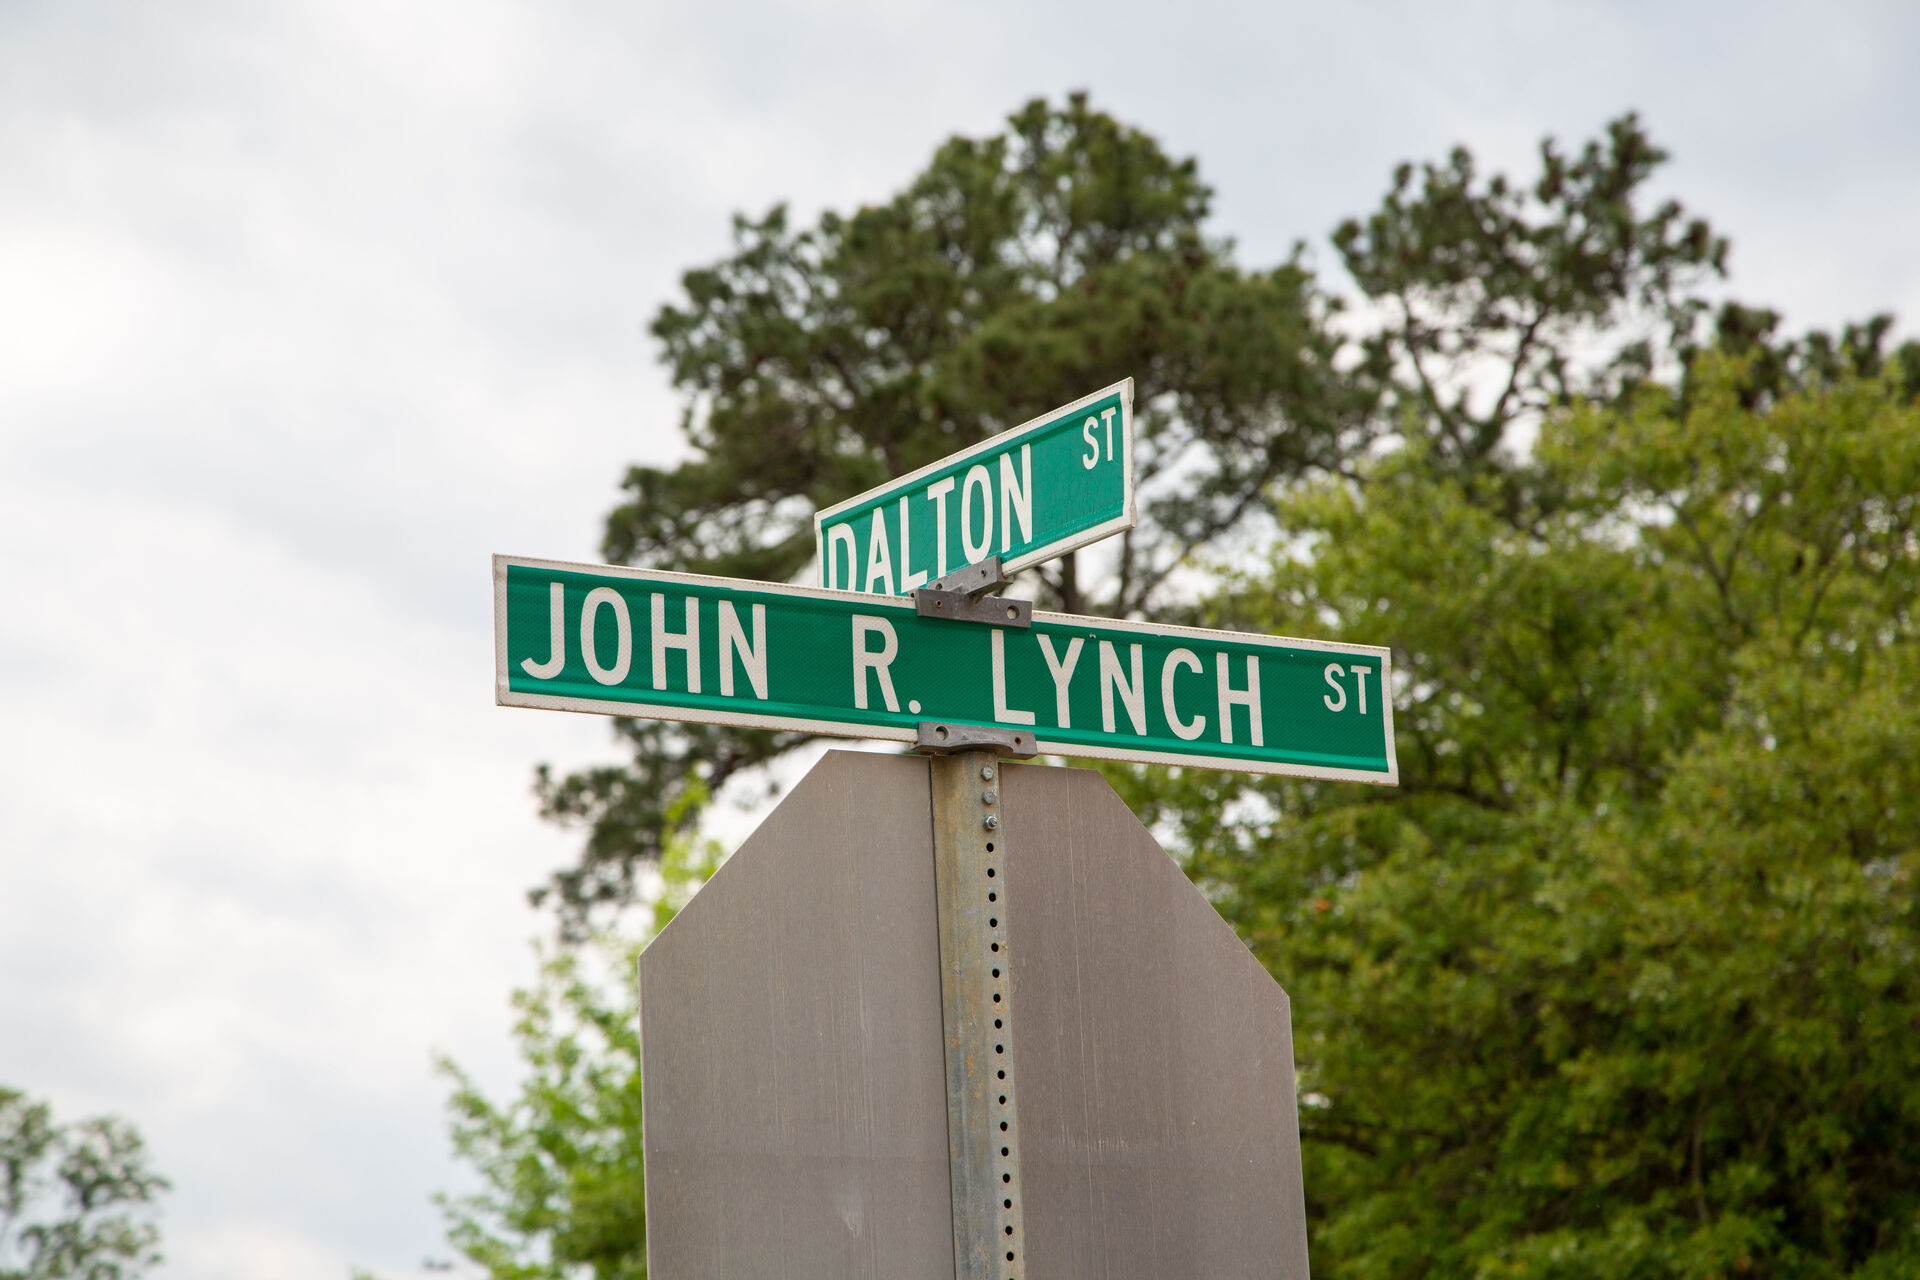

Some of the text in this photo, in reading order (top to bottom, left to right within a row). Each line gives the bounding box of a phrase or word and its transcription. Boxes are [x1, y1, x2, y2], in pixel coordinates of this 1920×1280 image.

[828, 406, 1117, 595] DALTON ST
[520, 581, 1372, 747] JOHN R. LYNCH ST
